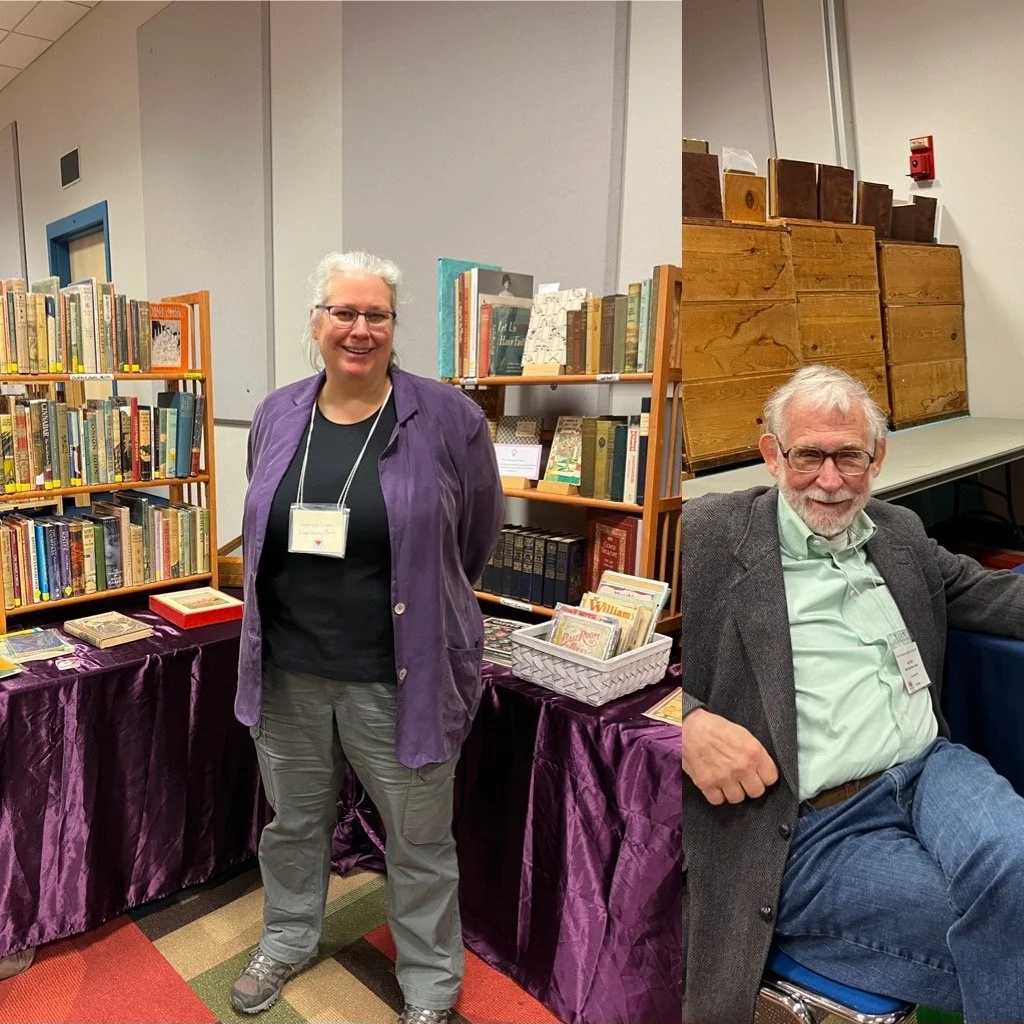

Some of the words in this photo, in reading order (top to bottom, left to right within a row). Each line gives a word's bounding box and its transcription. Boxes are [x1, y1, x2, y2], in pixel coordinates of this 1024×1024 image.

[498, 321, 506, 333] Let
[41, 403, 49, 437] CINNABAR
[590, 599, 631, 619] William
